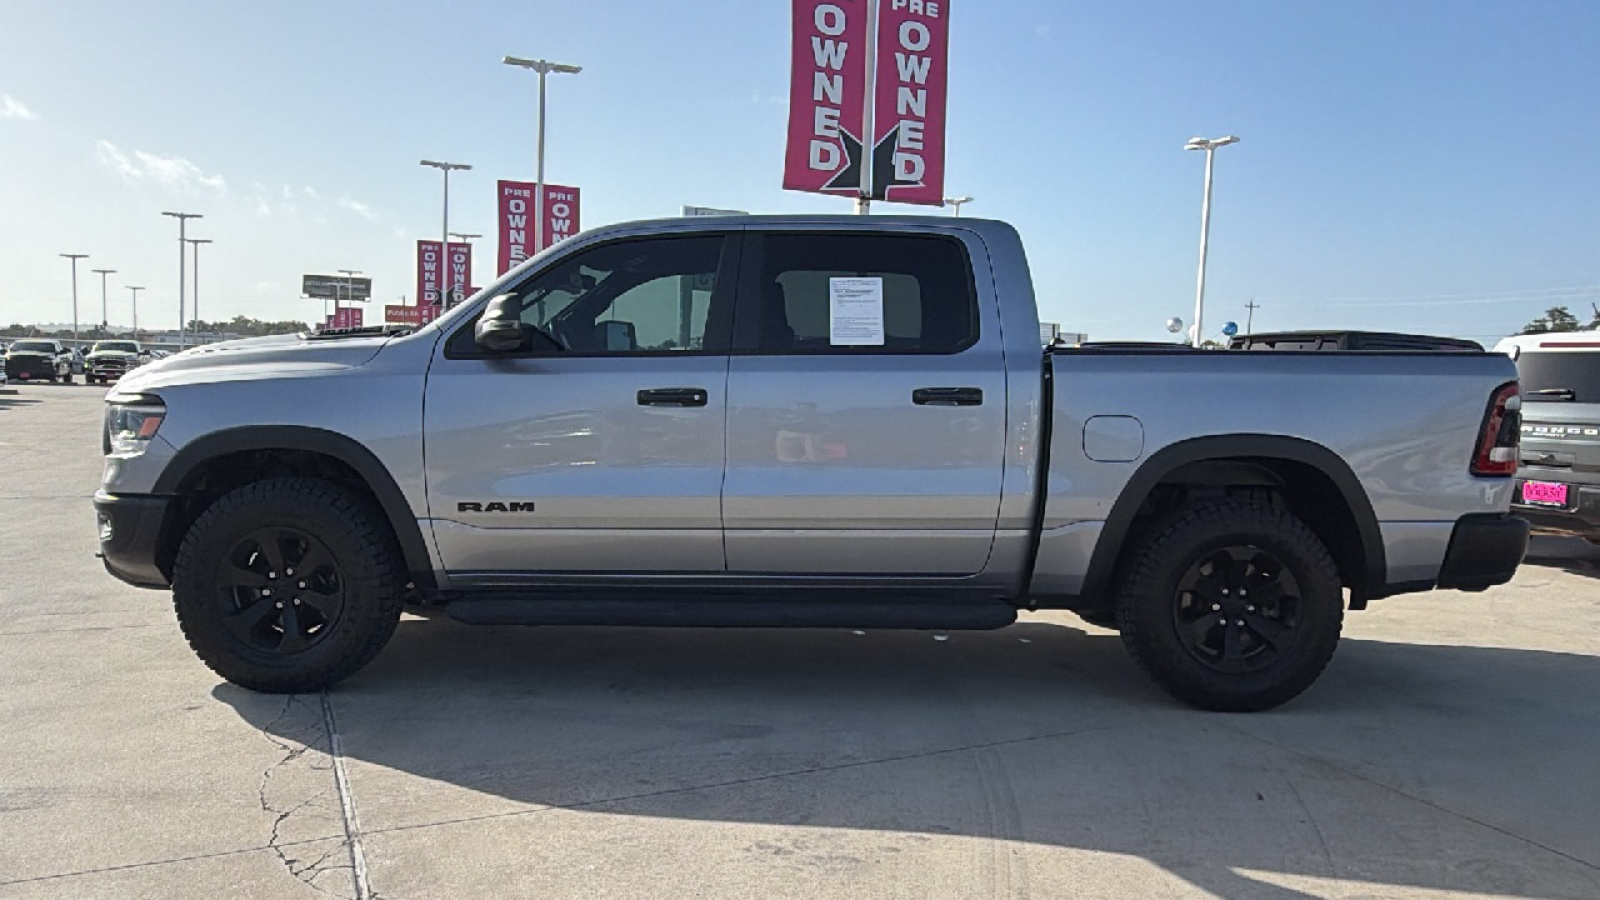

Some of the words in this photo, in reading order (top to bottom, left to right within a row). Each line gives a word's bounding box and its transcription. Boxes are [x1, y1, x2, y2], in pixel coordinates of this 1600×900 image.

[892, 0, 939, 18] PRE
[809, 4, 848, 171] OWNED
[895, 21, 931, 181] OWNED
[504, 187, 530, 198] PRE
[549, 192, 574, 201] PRE
[424, 252, 436, 300] OWNED
[452, 254, 465, 301] OWNED
[457, 502, 534, 512] RAM
